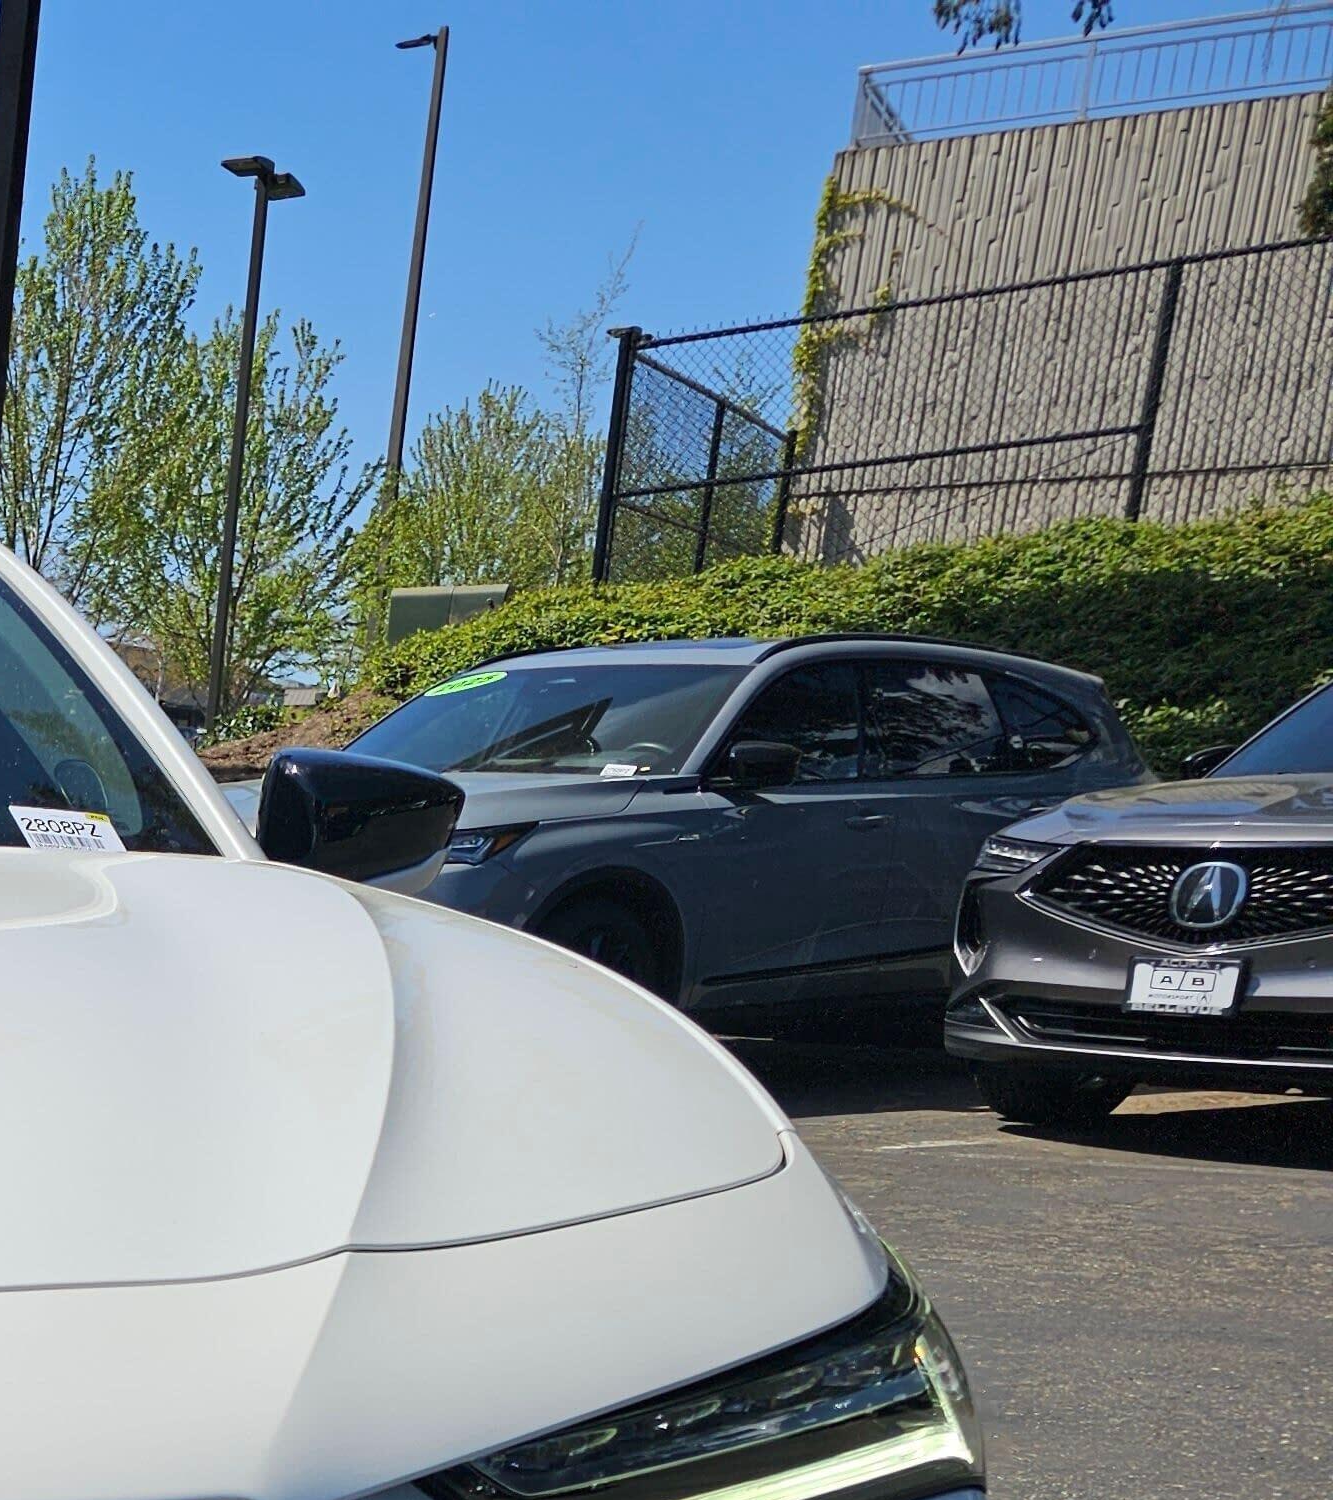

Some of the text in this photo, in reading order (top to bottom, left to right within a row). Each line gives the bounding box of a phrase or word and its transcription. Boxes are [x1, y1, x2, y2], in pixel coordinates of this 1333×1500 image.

[20, 817, 103, 838] 2808PZ
[1159, 959, 1210, 969] ACURA
[1159, 975, 1205, 986] A B
[1127, 1000, 1223, 1015] BELLEVUE
